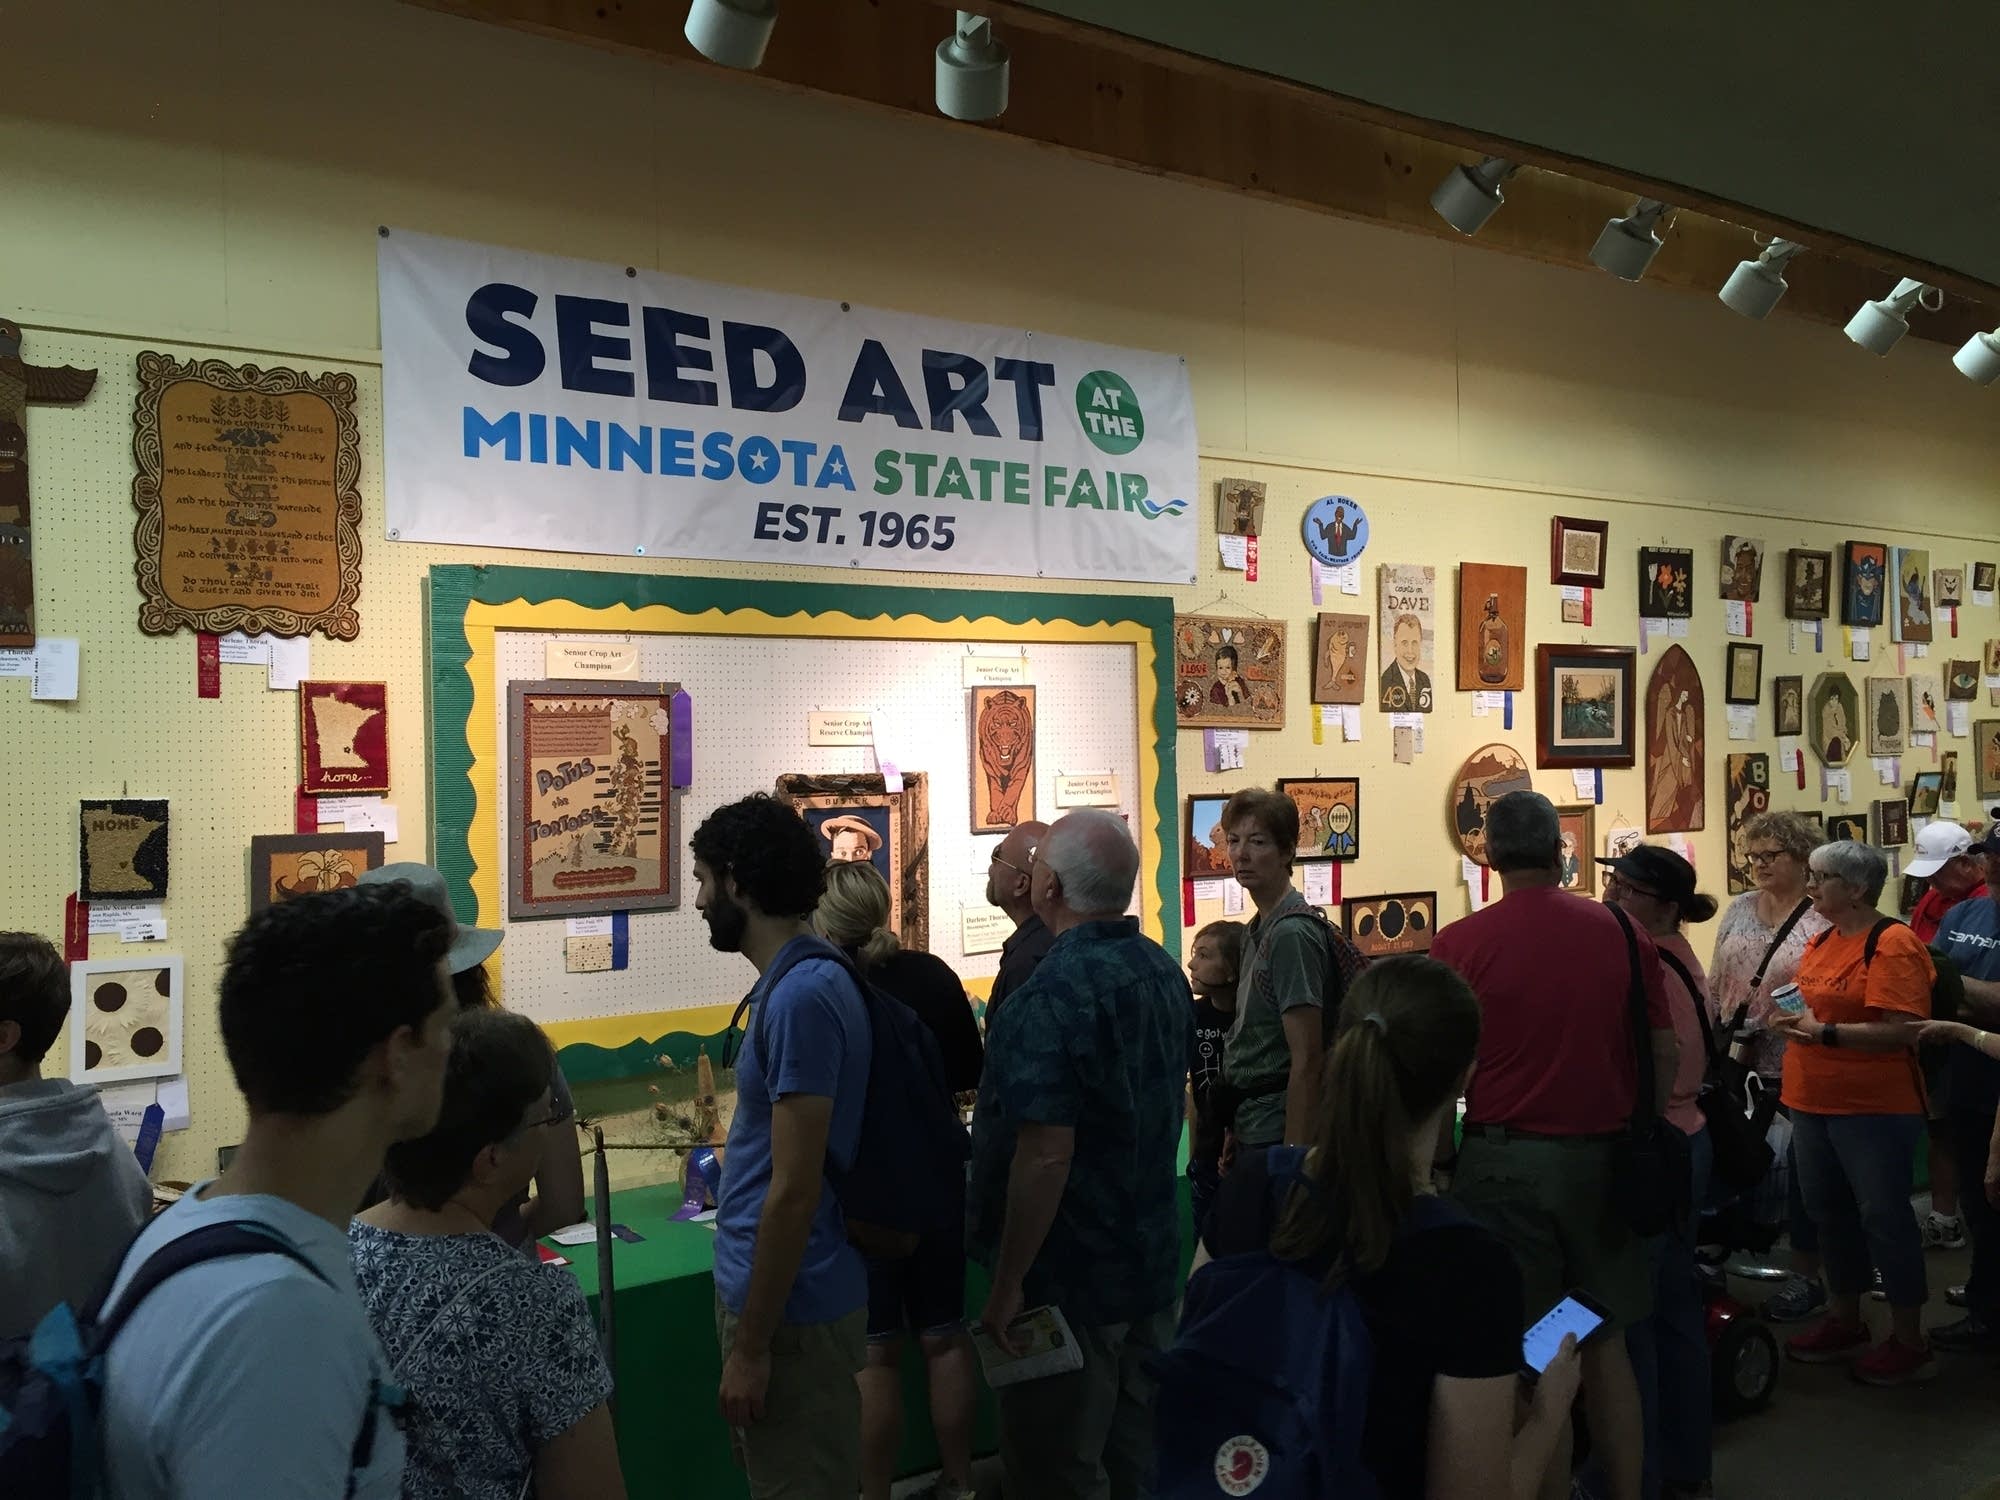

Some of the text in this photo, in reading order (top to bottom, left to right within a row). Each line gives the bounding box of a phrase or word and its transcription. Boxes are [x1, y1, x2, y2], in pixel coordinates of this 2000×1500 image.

[465, 283, 1055, 441] SEED ART
[1091, 387, 1122, 410] AT
[1085, 412, 1137, 438] THE
[463, 406, 1155, 519] MINNESOTA STATE FAIR
[754, 502, 955, 552] EST. 1965
[1388, 596, 1430, 611] DAVE
[563, 648, 588, 656] Senior
[589, 649, 608, 658] Crop
[574, 661, 612, 670] Champion
[1382, 686, 1432, 708] 40 5
[844, 720, 860, 728] Crop
[844, 729, 872, 737] Champio
[320, 770, 362, 783] home
[92, 819, 140, 832] HOME
